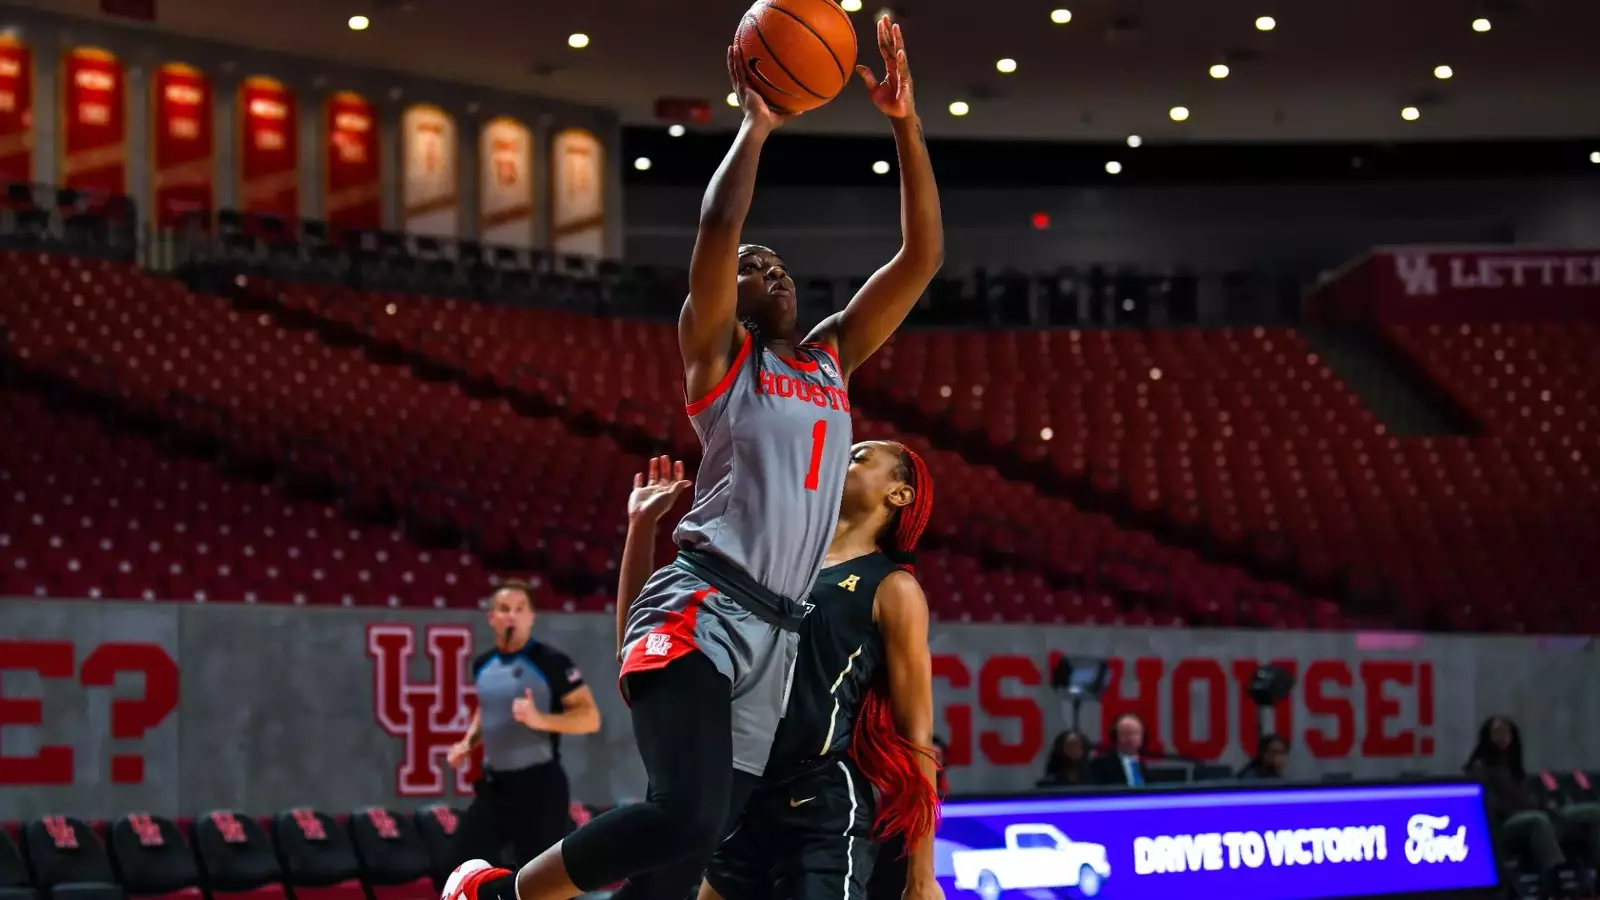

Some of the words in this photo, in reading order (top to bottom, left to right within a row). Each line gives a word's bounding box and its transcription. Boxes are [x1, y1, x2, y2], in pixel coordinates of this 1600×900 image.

[803, 419, 827, 491] 1
[837, 574, 860, 593] A
[1098, 656, 1435, 760] HOUSE!
[1133, 832, 1224, 876] DRIVE
[1222, 829, 1266, 869] TO
[1263, 822, 1388, 867] VICTORY!
[1403, 812, 1470, 866] Ford
